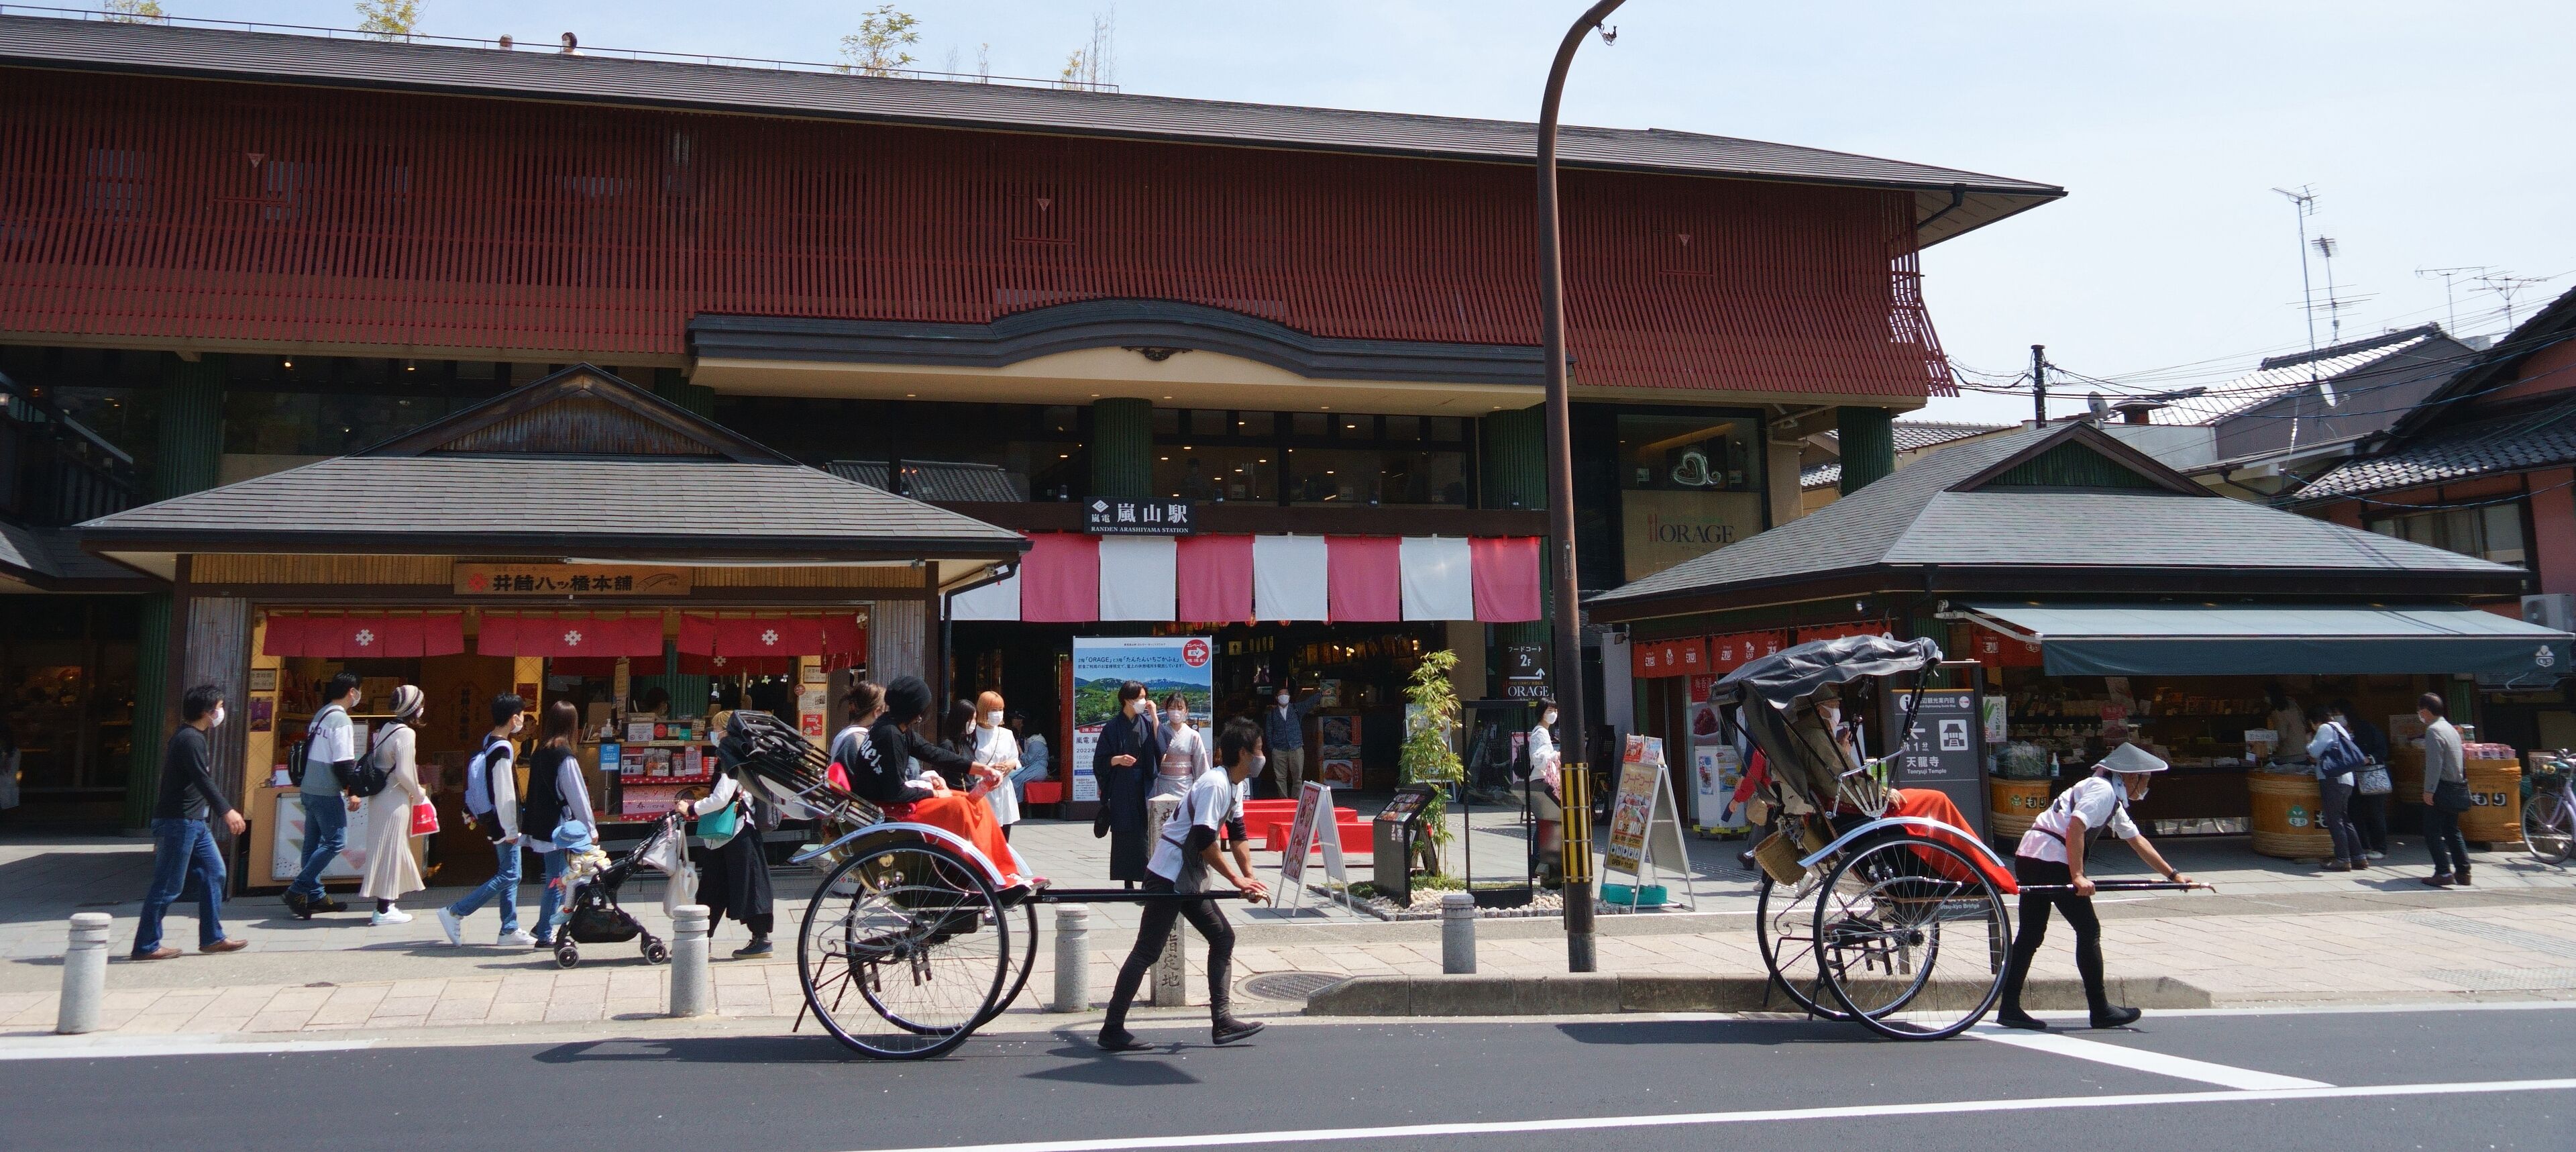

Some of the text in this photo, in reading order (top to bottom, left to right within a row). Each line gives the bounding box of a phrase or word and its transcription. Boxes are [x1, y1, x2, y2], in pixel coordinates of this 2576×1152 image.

[1091, 503, 1188, 523] 嵐電 嵐山駅
[1659, 525, 1735, 543] ORAGE
[1520, 654, 1532, 666] 2F
[1508, 686, 1549, 696] ORAGE
[1914, 743, 1919, 751] 1
[1907, 756, 1939, 768] 天龍寺
[2026, 796, 2047, 808] もり
[1612, 858, 1634, 870] OPEN 11:00
